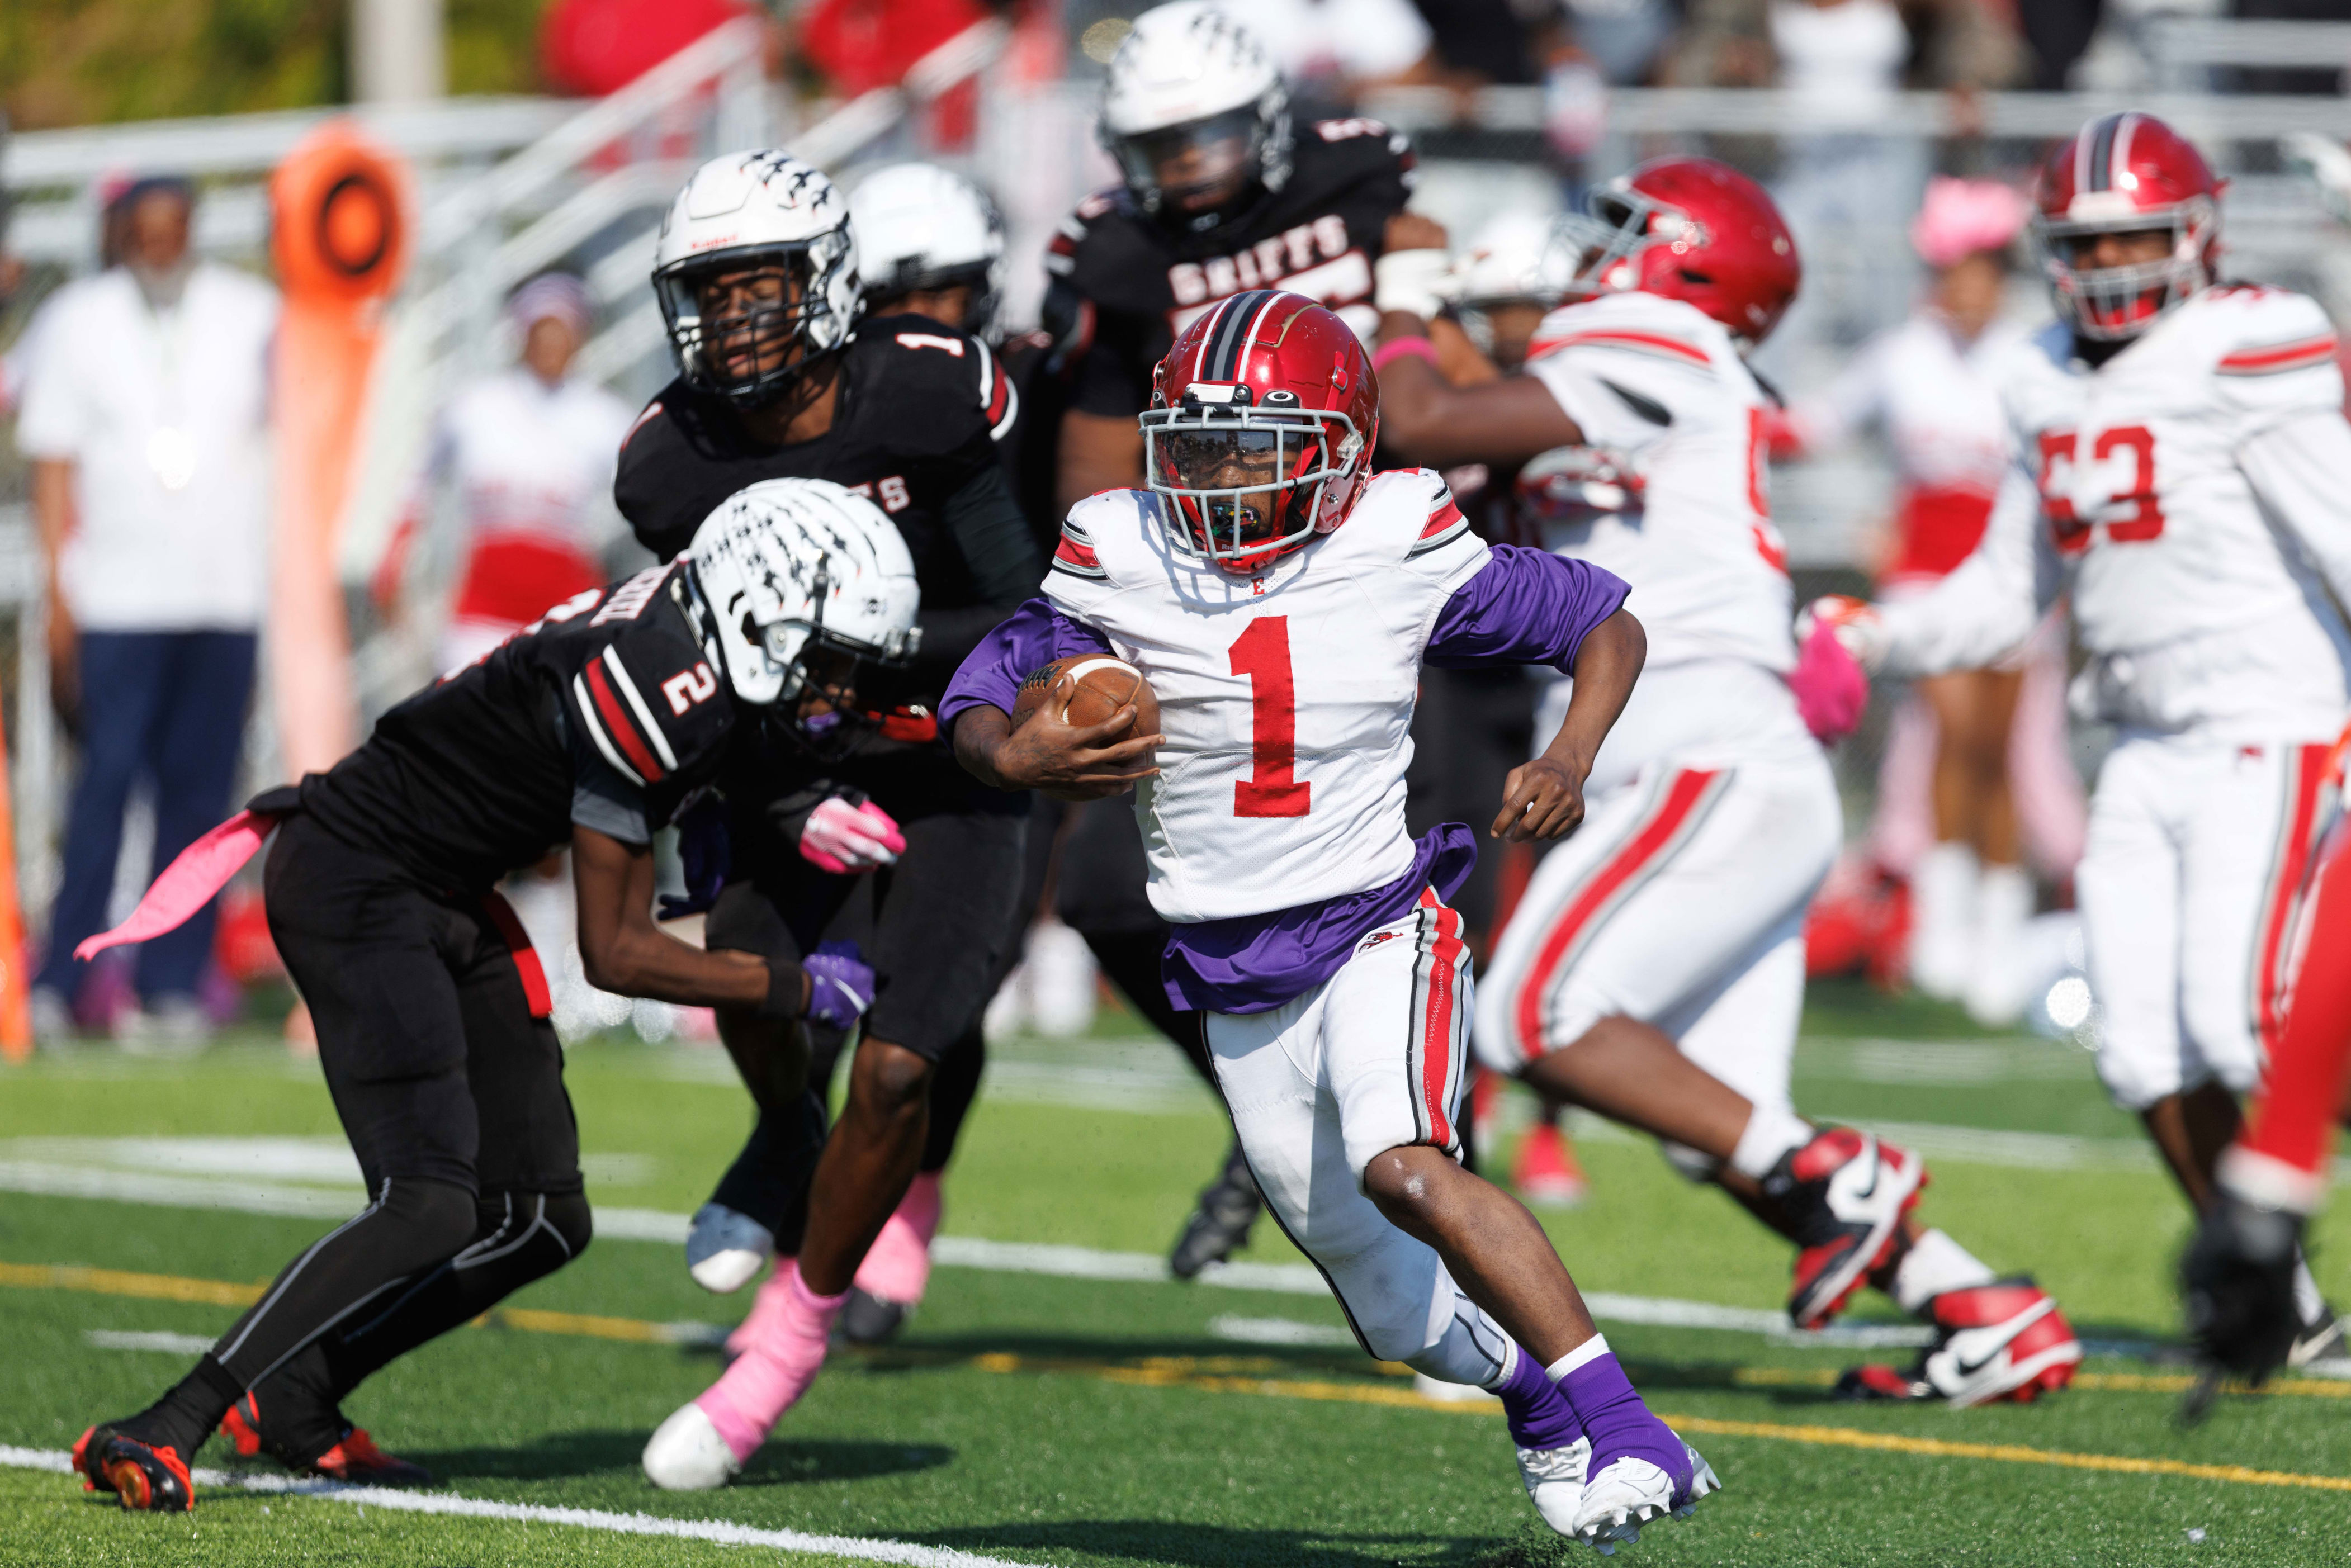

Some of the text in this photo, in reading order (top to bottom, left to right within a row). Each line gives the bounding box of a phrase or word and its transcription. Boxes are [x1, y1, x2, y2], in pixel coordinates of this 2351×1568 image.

[895, 332, 966, 358] 1
[2036, 425, 2165, 555] 53
[1251, 576, 1265, 595] E
[659, 660, 718, 718] 2
[1228, 615, 1311, 818] 1
